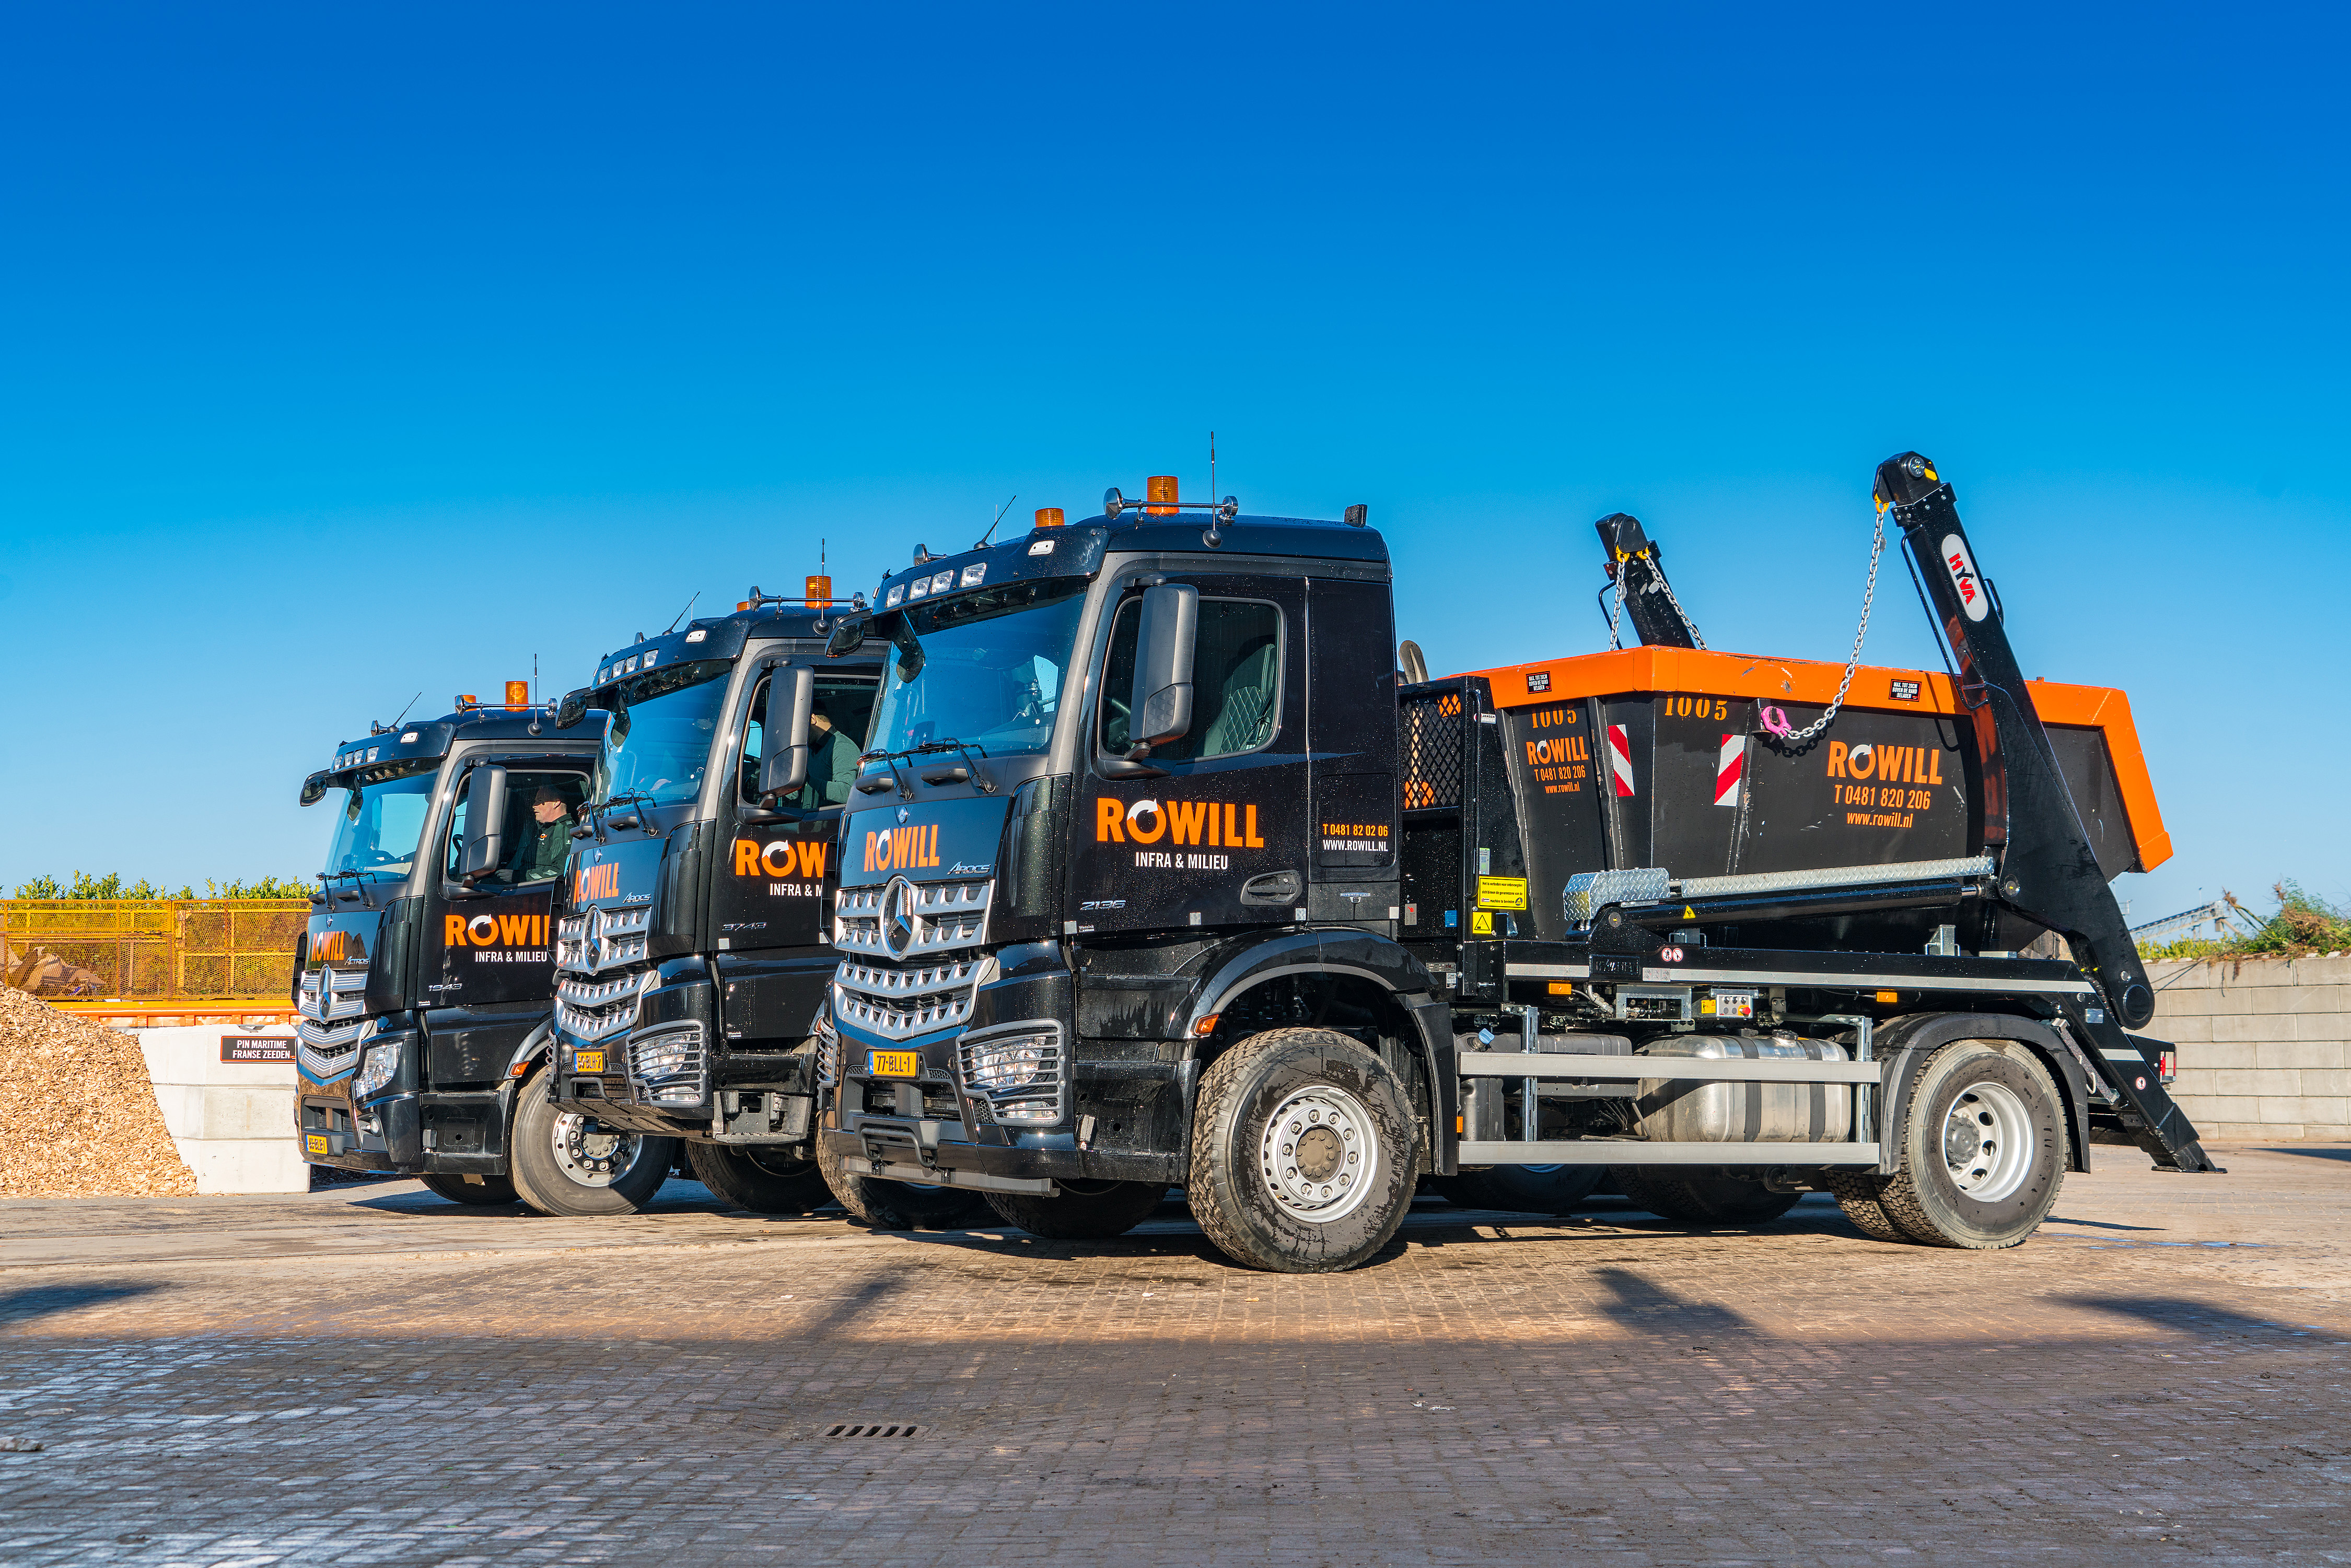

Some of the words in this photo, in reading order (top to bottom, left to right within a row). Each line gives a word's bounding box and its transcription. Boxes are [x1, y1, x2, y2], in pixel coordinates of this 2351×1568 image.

[1949, 553, 1975, 605] HYVA
[1531, 703, 1577, 728] 1005
[1665, 695, 1727, 720] 1005
[1526, 736, 1589, 765] ROWILL
[1828, 741, 1942, 785] ROWILL
[1534, 769, 1539, 781] T
[1540, 767, 1557, 781] 0481
[1558, 766, 1572, 780] 820
[1573, 765, 1586, 778] 206
[1544, 781, 1580, 793] www.rowill.nl
[1835, 785, 1842, 803] T
[1845, 786, 1876, 806] 0481
[1881, 788, 1904, 808] 820
[1907, 790, 1931, 810] 206
[1097, 798, 1264, 848] ROWILL
[1847, 812, 1913, 828] www.rowill.nl
[1323, 824, 1328, 835] T
[1330, 824, 1349, 835] 0481
[1353, 824, 1363, 836] 82
[1366, 825, 1376, 836] 02
[1378, 825, 1388, 836] 06
[864, 824, 940, 872] ROWILL
[1323, 839, 1388, 851] WWW.ROWILL.NL
[736, 839, 827, 878] ROW
[1136, 852, 1171, 868] INFRA
[1175, 853, 1184, 868] &
[1188, 853, 1228, 870] MILIEU
[574, 862, 619, 904] ROWILL
[770, 883, 801, 896] INFRA
[805, 884, 812, 897] &
[1080, 900, 1126, 910] 2136
[445, 914, 550, 946] ROWI
[722, 922, 766, 931] 3743
[311, 930, 345, 962] ROWILL
[475, 951, 504, 962] INFRA
[506, 951, 513, 962] &
[516, 951, 548, 962] MILIEU
[428, 983, 462, 991] 1943
[237, 1040, 250, 1048] PIN
[251, 1040, 287, 1049] MARITIME
[232, 1050, 261, 1059] FRANSE
[263, 1050, 290, 1059] ZEEDEN
[877, 1055, 910, 1072] 77-BLL-1
